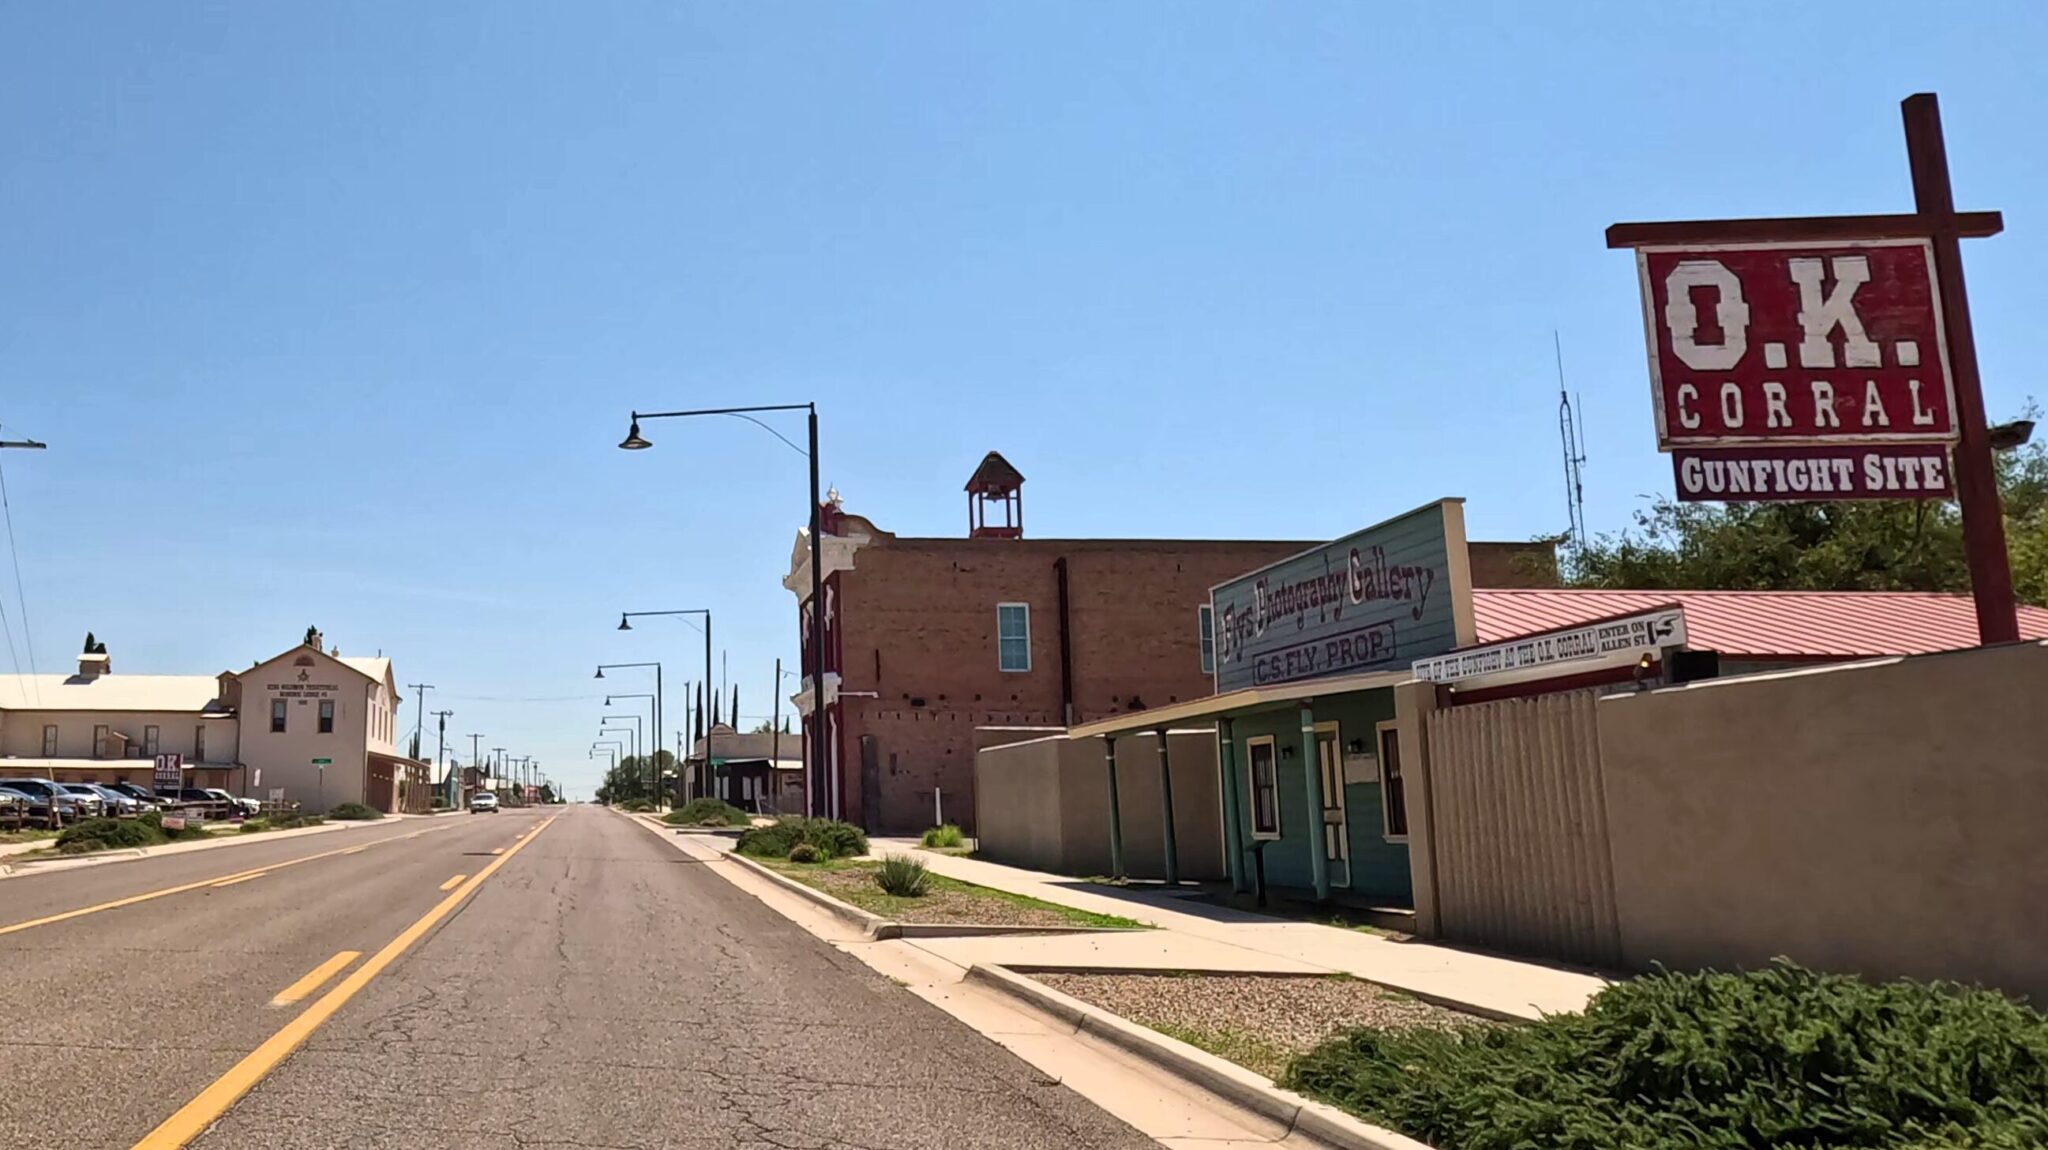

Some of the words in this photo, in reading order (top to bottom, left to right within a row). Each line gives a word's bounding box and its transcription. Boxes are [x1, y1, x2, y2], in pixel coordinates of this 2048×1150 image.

[1665, 255, 1919, 370] O.K.
[1677, 380, 1934, 429] CORRAL
[1681, 457, 1854, 494] GUNFIGHT
[1863, 454, 1945, 490] SITE
[1254, 552, 1347, 638] Photography
[1348, 546, 1434, 621] Gallery
[1517, 643, 1536, 666] THE
[1556, 632, 1595, 658] CORRAL
[1598, 624, 1629, 639] ENTER
[1631, 621, 1645, 633] ON
[1601, 637, 1631, 652] ALLEN
